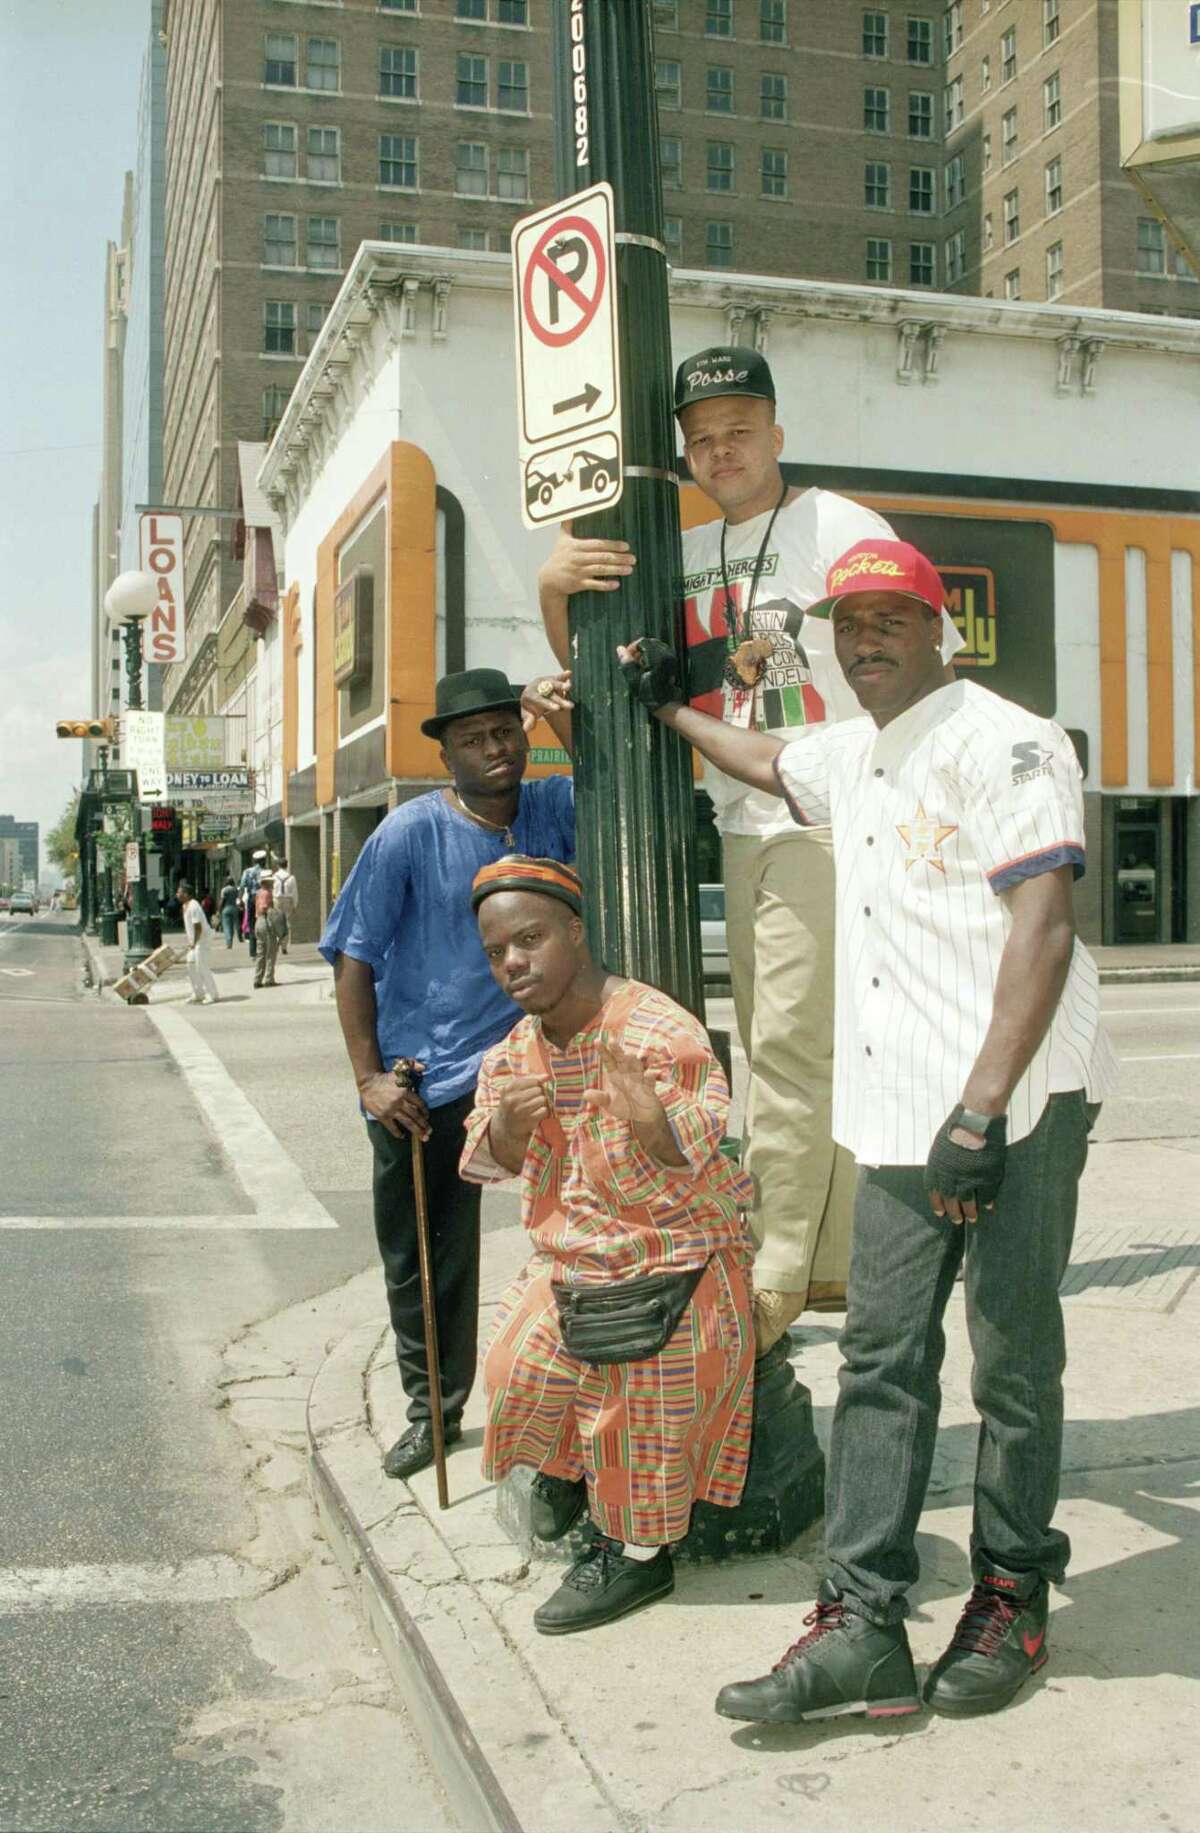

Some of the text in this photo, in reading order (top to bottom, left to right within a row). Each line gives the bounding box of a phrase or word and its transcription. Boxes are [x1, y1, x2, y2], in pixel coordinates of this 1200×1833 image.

[687, 369, 749, 392] Posse
[149, 518, 177, 661] LOANS
[138, 716, 153, 724] NO
[130, 726, 160, 735] RIGHT
[142, 768, 161, 776] ONE
[142, 778, 162, 787] WAY
[167, 773, 199, 785] ONEY
[212, 773, 248, 785] LOAN
